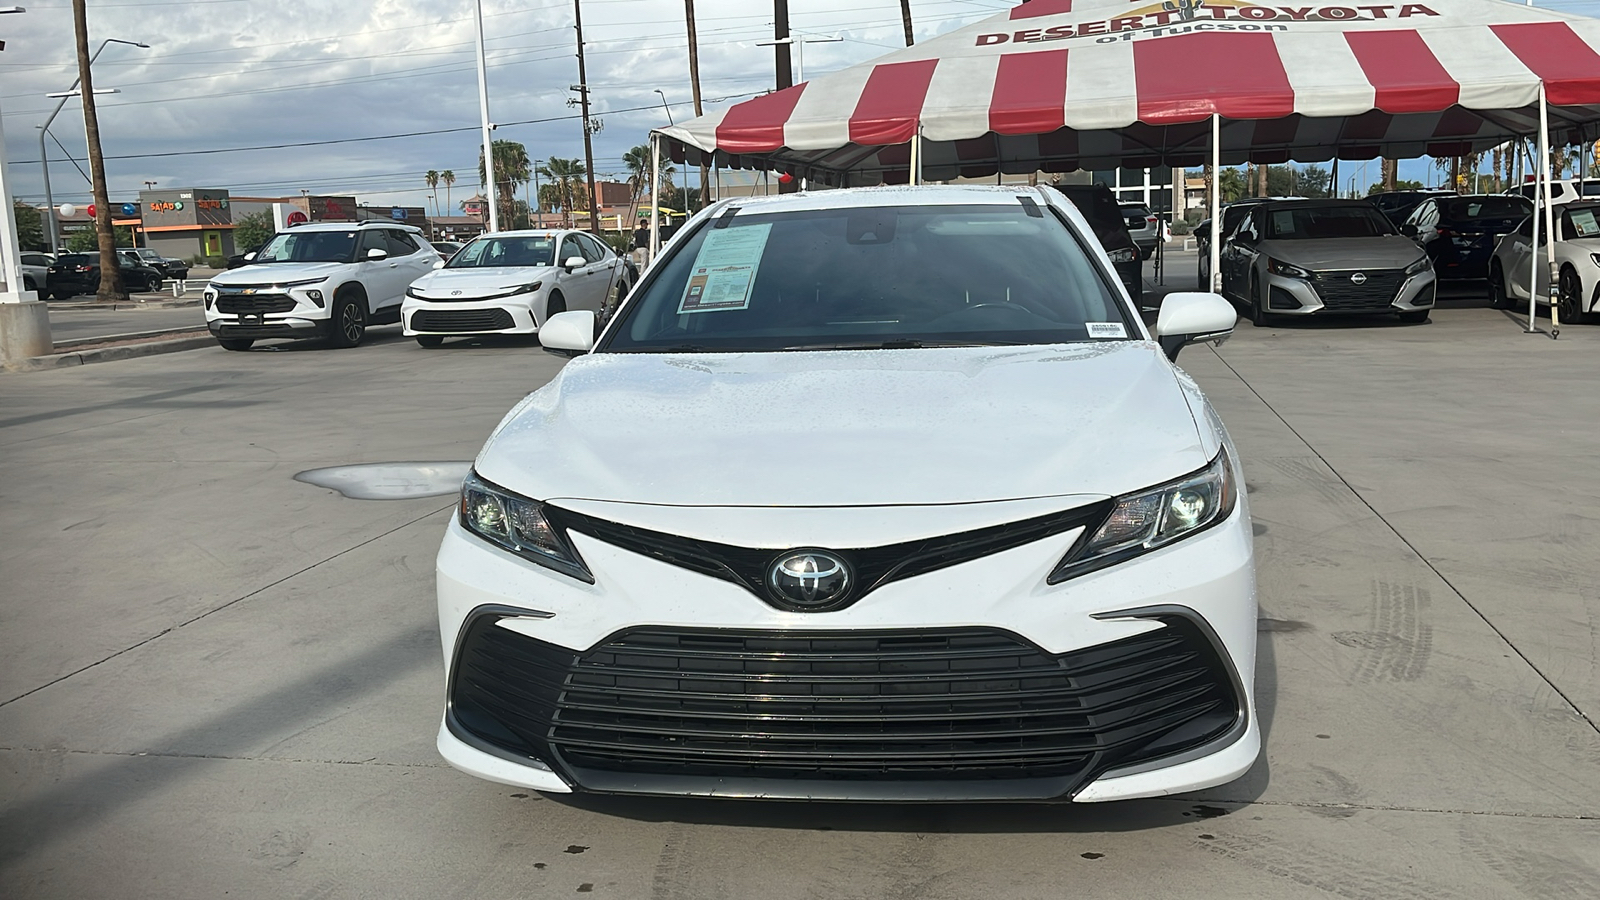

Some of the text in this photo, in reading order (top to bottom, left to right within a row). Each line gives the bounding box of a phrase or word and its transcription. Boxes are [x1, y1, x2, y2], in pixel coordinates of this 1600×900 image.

[975, 4, 1441, 46] DESERT TOYOTA
[1095, 23, 1288, 44] of Tucson
